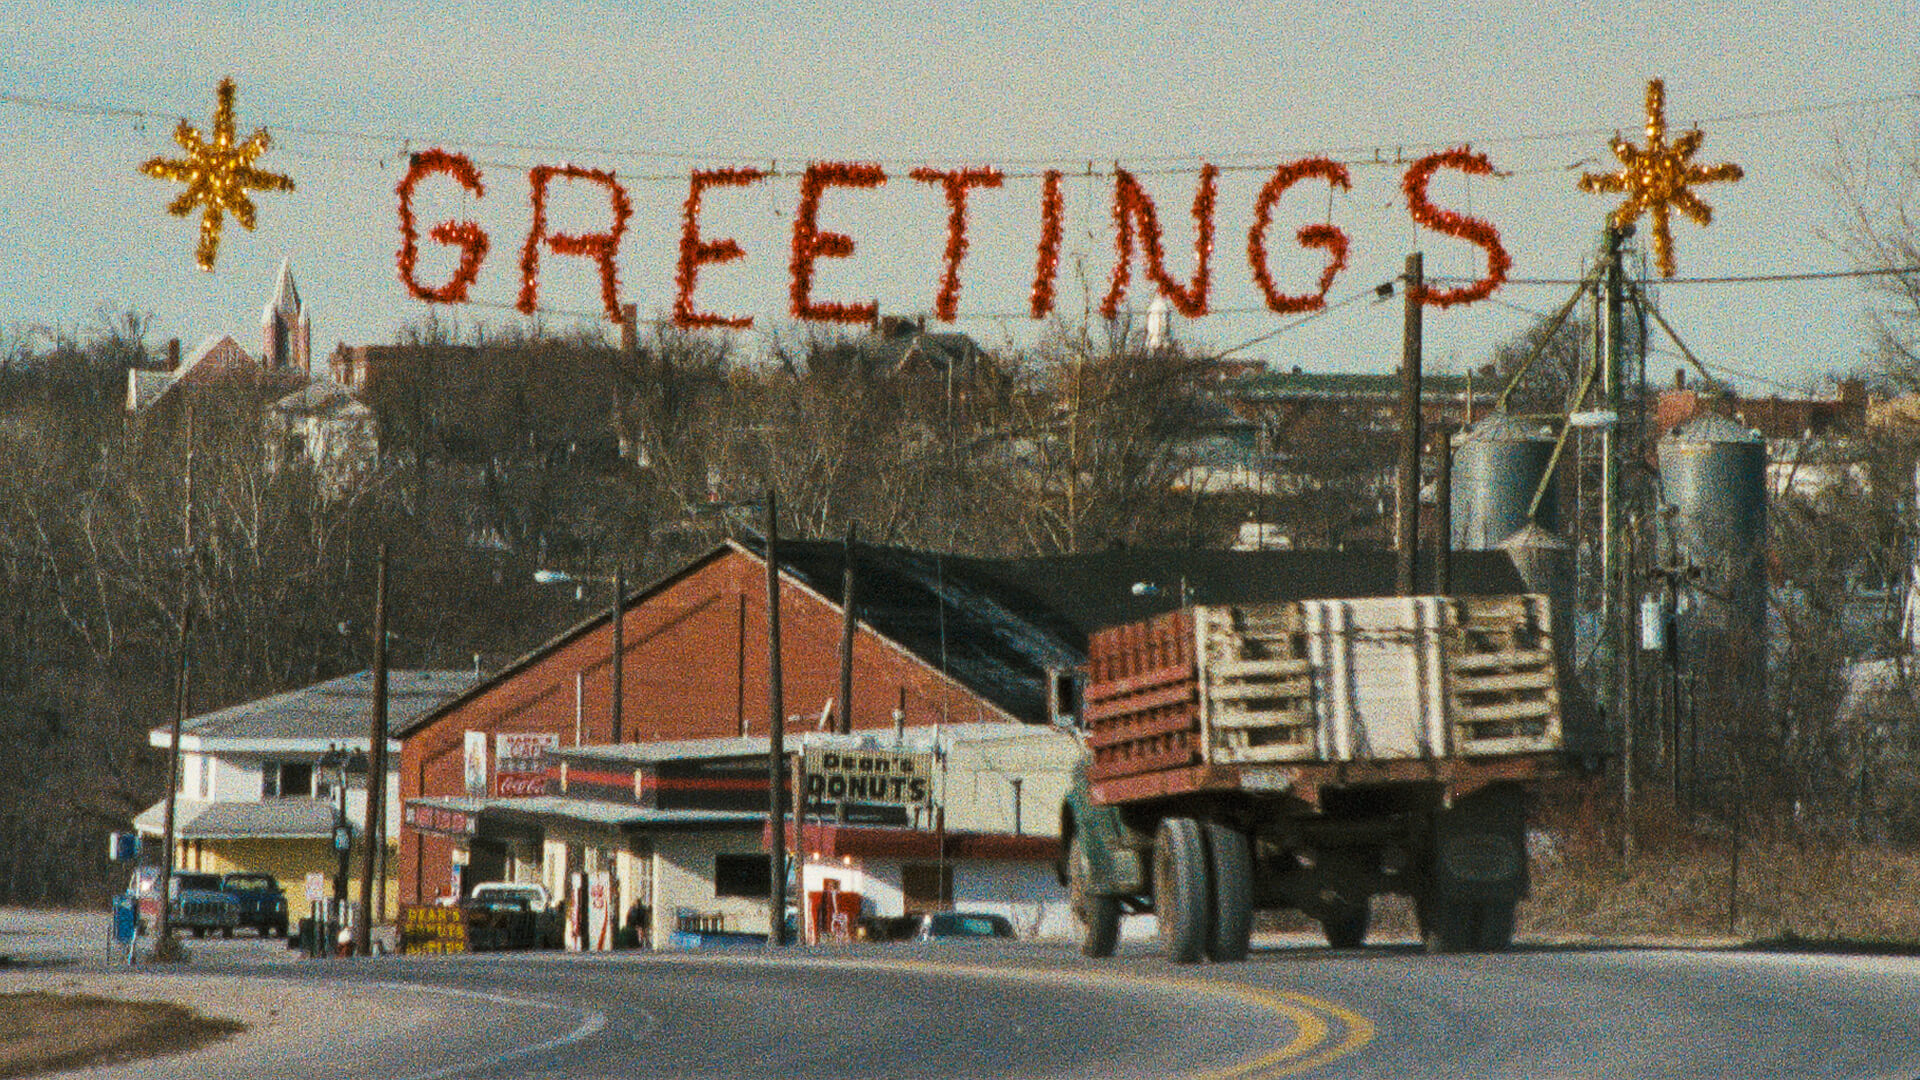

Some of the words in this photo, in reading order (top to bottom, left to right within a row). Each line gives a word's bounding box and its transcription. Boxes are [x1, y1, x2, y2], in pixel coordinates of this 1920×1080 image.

[395, 144, 1513, 328] GREETINGS
[823, 752, 915, 772] Dean's
[807, 773, 927, 802] DONUTS
